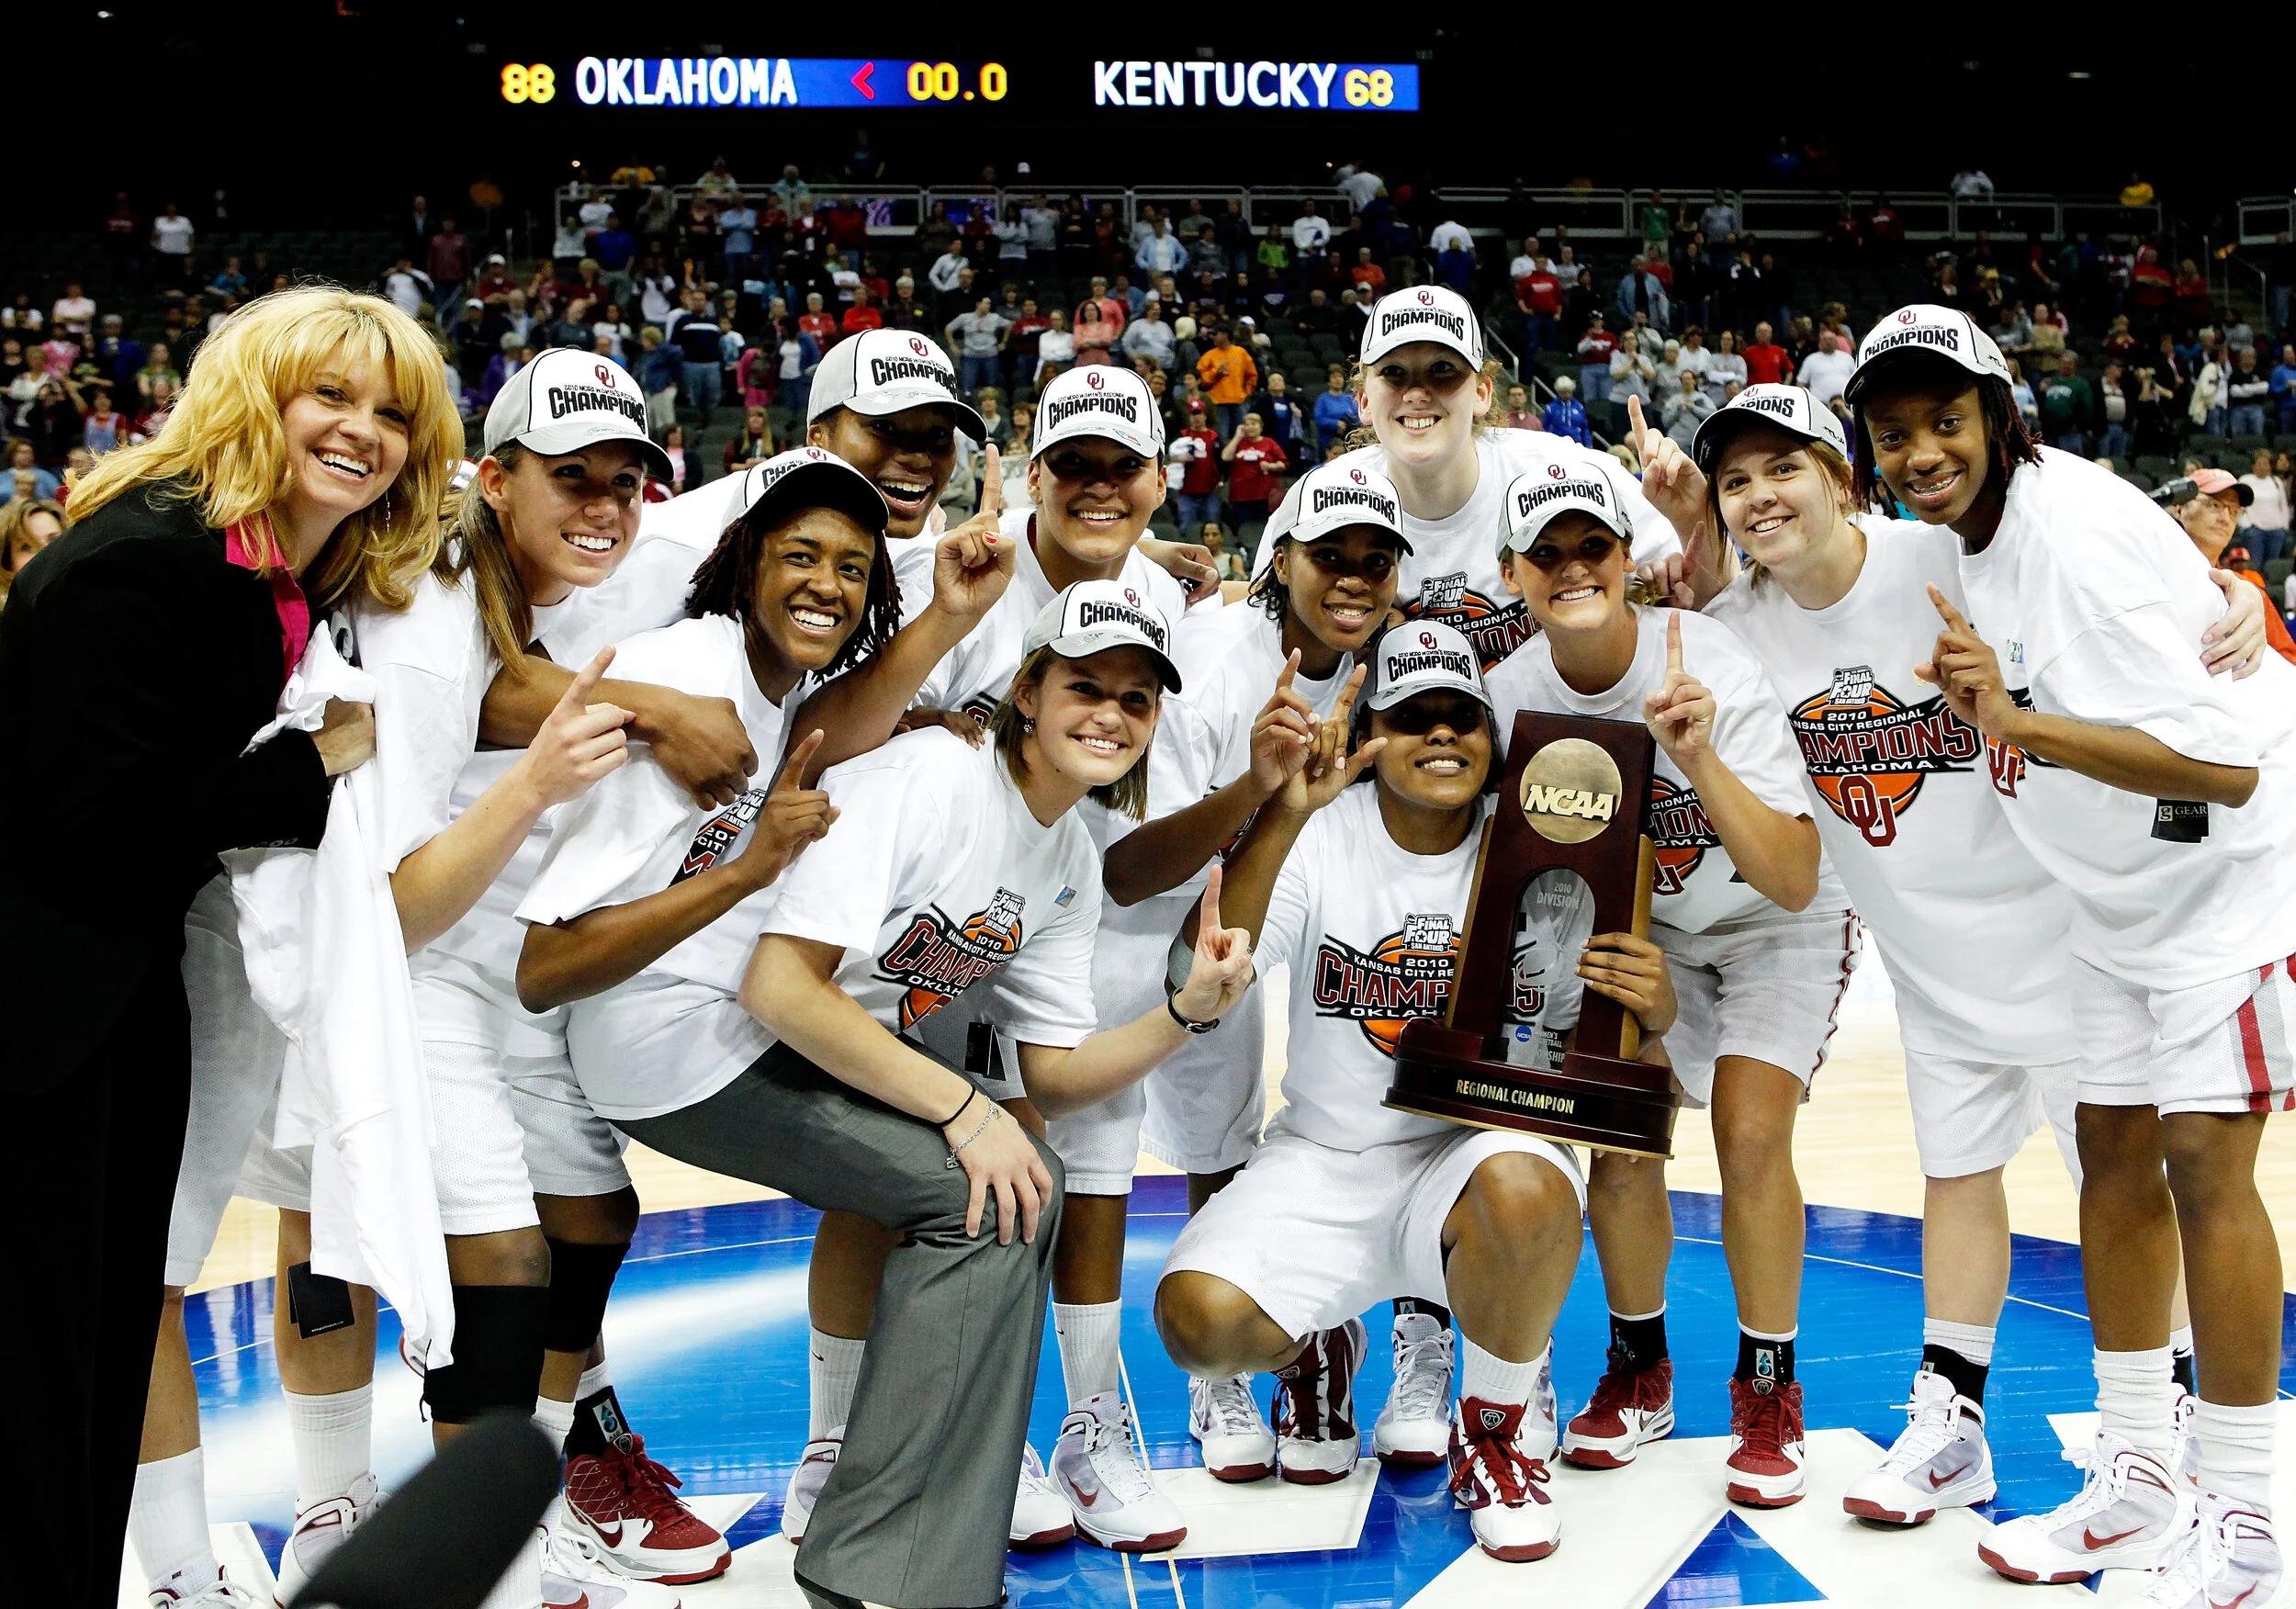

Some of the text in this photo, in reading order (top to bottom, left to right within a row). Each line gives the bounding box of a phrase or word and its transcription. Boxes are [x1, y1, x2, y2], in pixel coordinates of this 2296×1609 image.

[501, 63, 556, 104] 88
[575, 56, 798, 105] OKLAHOMA
[1094, 61, 1337, 107] KENTUCKY
[1345, 69, 1394, 107] 68
[1417, 290, 1434, 306] OU
[1382, 311, 1464, 341] CHAMPIONS
[1897, 310, 1917, 325] OU
[909, 338, 929, 357] OU
[595, 365, 615, 388] OU
[1087, 372, 1104, 390] OU
[548, 388, 646, 435] CHAMPIONS
[1049, 397, 1137, 430] CHAMPIONS
[1350, 468, 1367, 486] OU
[1548, 464, 1567, 479] OU
[1313, 489, 1395, 525] CHAMPIONS
[1517, 483, 1605, 518] CHAMPIONS
[1435, 578, 1465, 593] FINAL
[1124, 588, 1141, 608] OU
[1423, 588, 1464, 608] FOUR
[1080, 602, 1165, 652] CHAMPIONS
[1419, 631, 1437, 650] OU
[1387, 654, 1472, 682] CHAMPIONS
[1842, 671, 1873, 685] FINAL
[1829, 682, 1873, 700] FOUR
[1827, 711, 1867, 721] 2010
[1828, 723, 1853, 731] CITY
[1856, 708, 1925, 730] REGIONAL
[1799, 707, 1976, 764] AMPIONS
[1807, 760, 1933, 773] KLAHOMA
[1525, 784, 1615, 821] NCAA
[1651, 793, 1698, 810] GIONAL
[1838, 773, 1897, 848] OU
[2175, 805, 2208, 815] GEAR
[1554, 882, 1572, 894] 2010
[998, 894, 1021, 914] FINAL
[1536, 892, 1580, 910] DIVISION
[1417, 917, 1450, 930] FINAL
[1404, 924, 1450, 944] FOUR
[1354, 955, 1401, 975] KANSAS
[1404, 968, 1435, 978] CITY
[1406, 958, 1449, 968] 2010
[908, 975, 964, 996] OKLAH
[1350, 1007, 1437, 1017] OKLAH
[1457, 1079, 1575, 1114] REGIONAL CHAMPION
